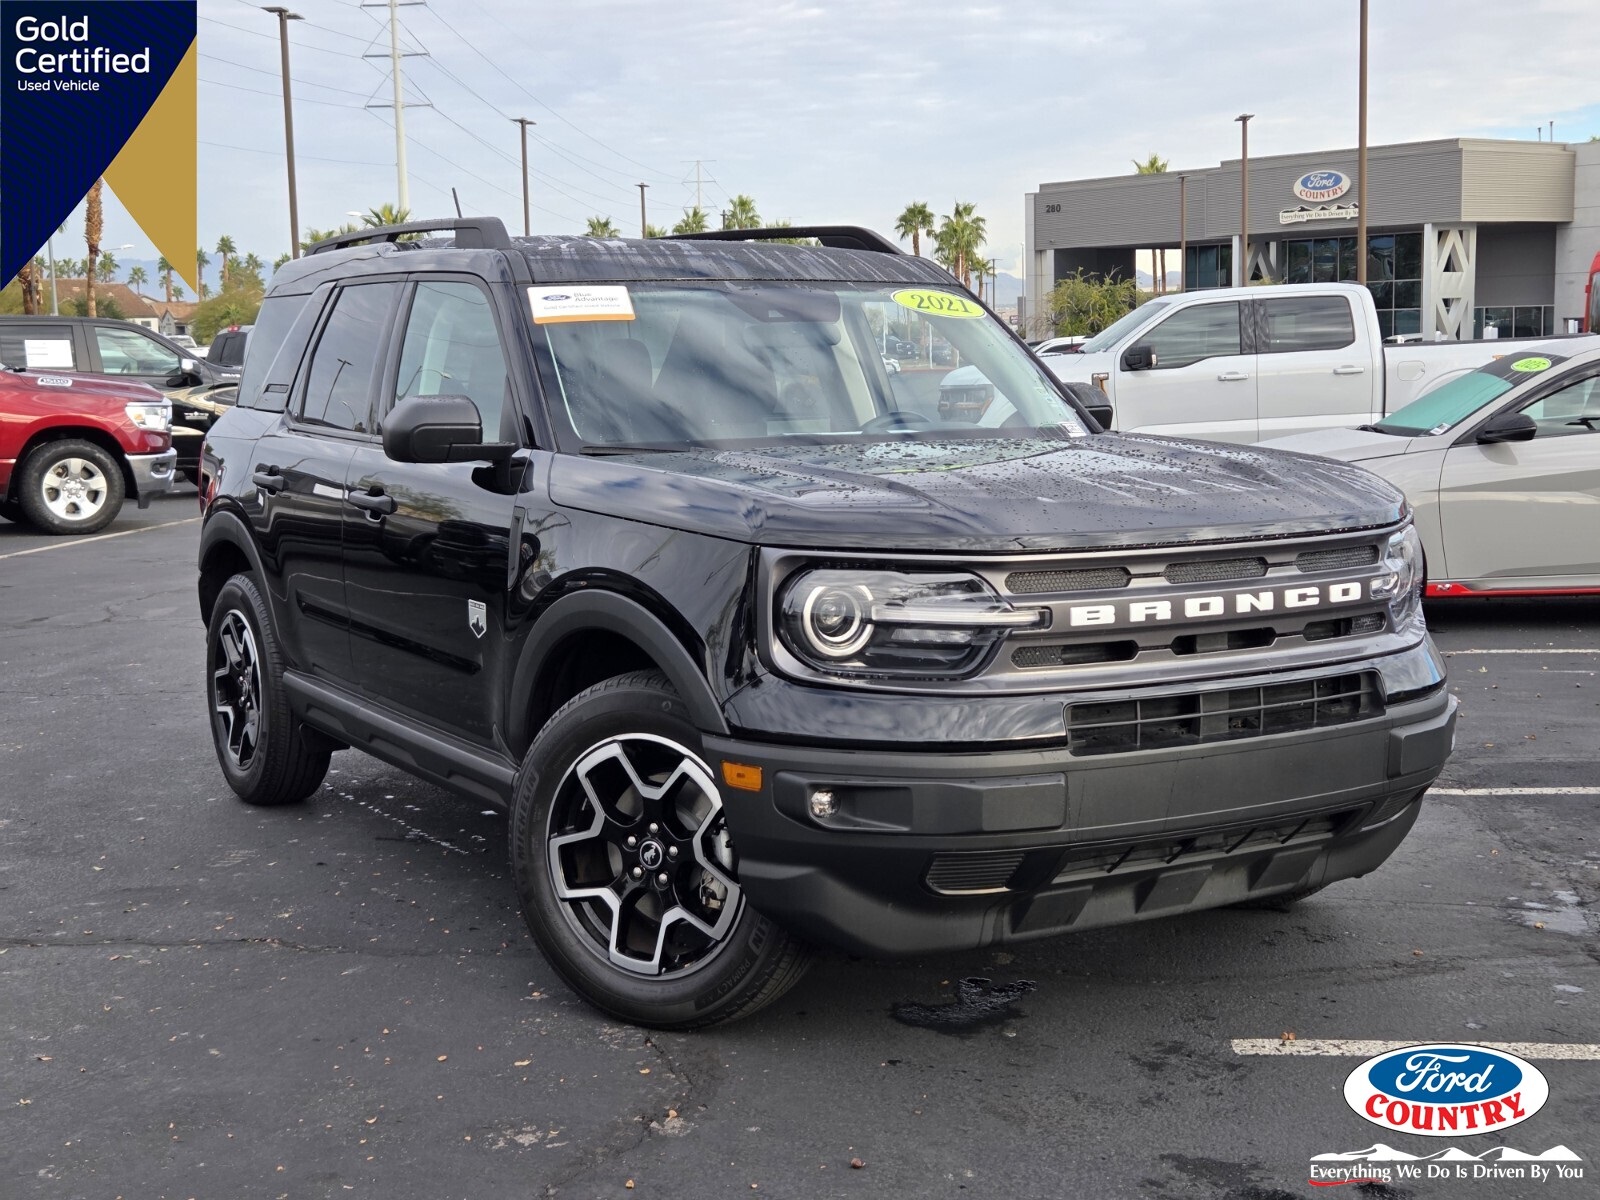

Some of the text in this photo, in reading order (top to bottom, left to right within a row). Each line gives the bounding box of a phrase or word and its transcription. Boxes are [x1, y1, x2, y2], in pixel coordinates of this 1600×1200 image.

[1307, 173, 1336, 188] Ford
[1299, 185, 1344, 199] COUNTRY
[1046, 204, 1061, 213] 280
[1281, 211, 1305, 220] Everything
[911, 293, 973, 314] 2021
[1070, 582, 1362, 627] BRONCO
